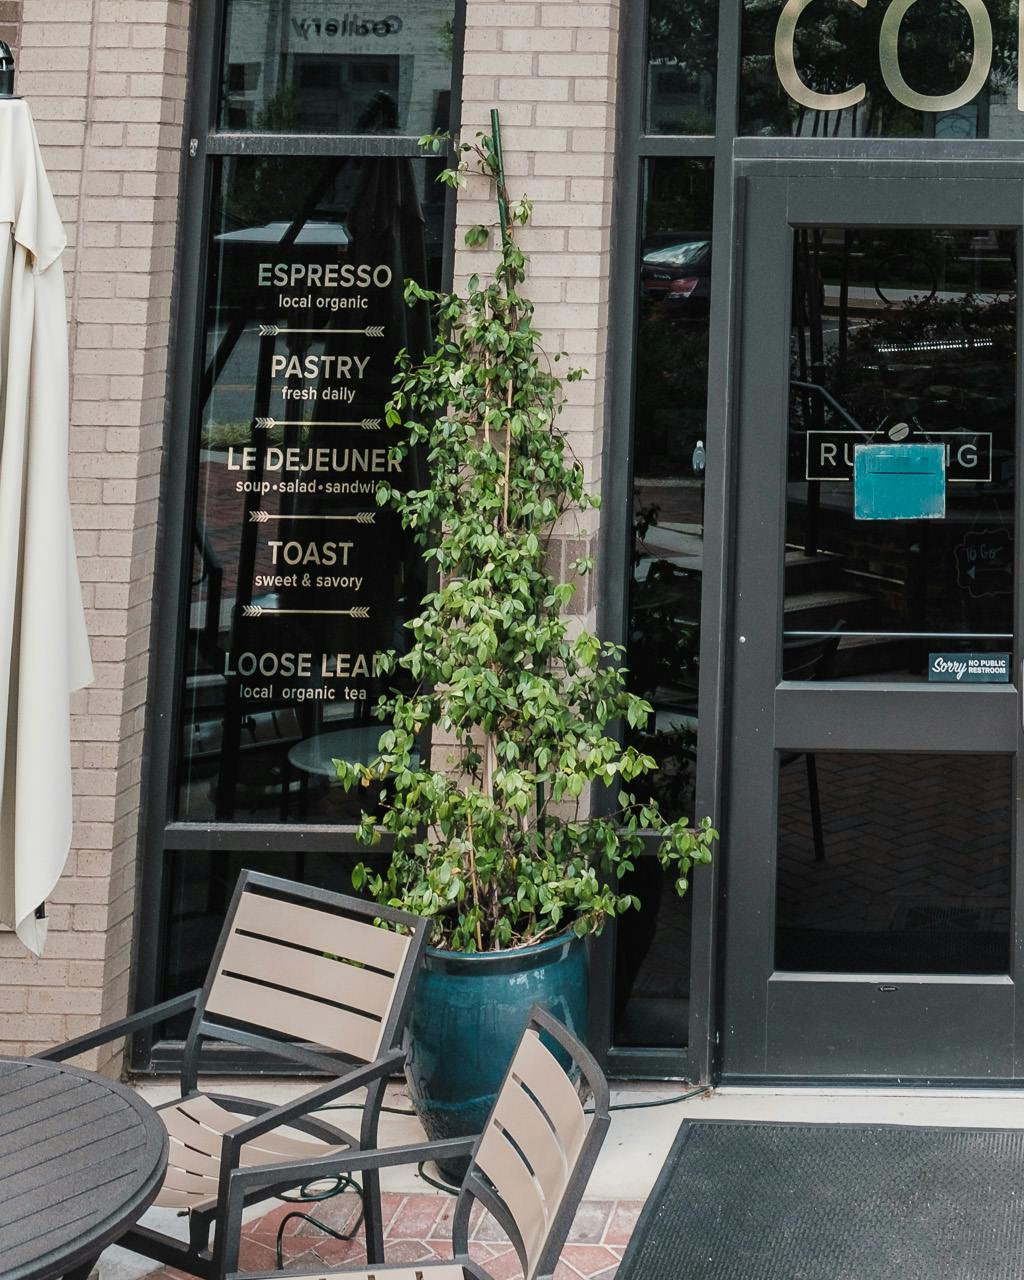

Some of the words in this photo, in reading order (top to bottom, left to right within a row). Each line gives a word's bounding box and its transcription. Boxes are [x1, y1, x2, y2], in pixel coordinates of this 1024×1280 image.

[258, 263, 393, 289] ESPRESSO
[278, 293, 312, 309] local
[316, 295, 369, 312] organic
[271, 355, 371, 380] PASTRY
[281, 385, 317, 401] fresh
[321, 385, 356, 404] daily
[227, 447, 257, 471] LE
[266, 447, 403, 473] DEJEUNER
[268, 541, 355, 567] TOAST
[254, 572, 298, 588] sweet
[301, 572, 312, 587] &
[316, 574, 363, 591] savory
[224, 652, 312, 677] LOOSE
[931, 657, 968, 680] Sorry
[968, 659, 979, 667] NO
[980, 659, 1006, 667] PUBLIC
[239, 684, 273, 699] local
[282, 685, 336, 702] organic
[344, 687, 367, 700] tea
